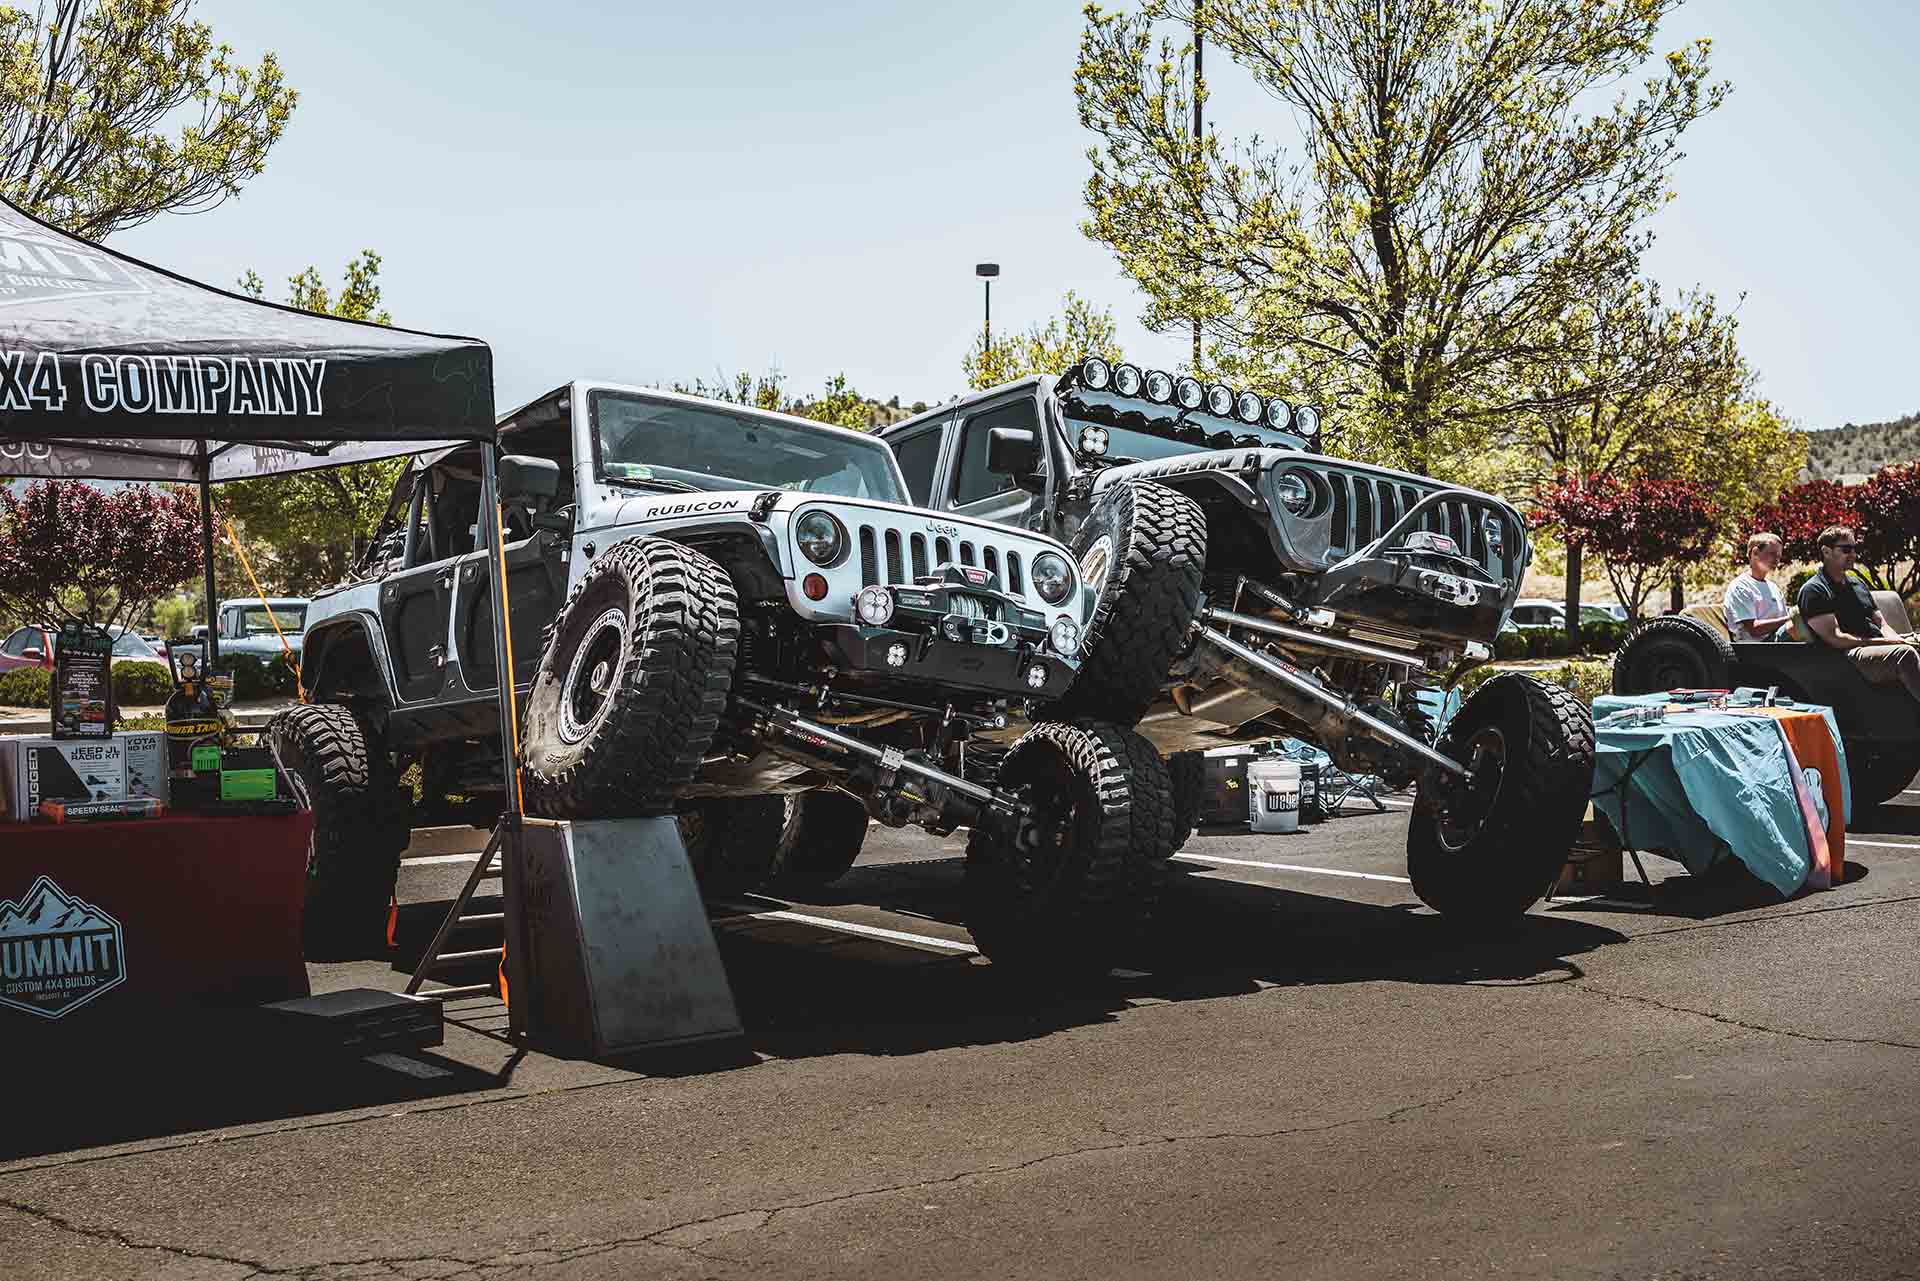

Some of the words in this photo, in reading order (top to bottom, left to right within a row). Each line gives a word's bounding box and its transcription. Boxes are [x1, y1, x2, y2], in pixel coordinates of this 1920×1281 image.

[80, 353, 327, 416] COMPANY
[646, 500, 739, 518] RUBICON
[926, 520, 959, 538] Jeep
[71, 746, 103, 755] JEEP
[71, 753, 103, 761] RADIO
[28, 748, 40, 816] RUGGED
[1268, 791, 1299, 811] webe
[0, 932, 114, 979] UMMIT
[6, 981, 43, 994] CUSTOM
[45, 978, 64, 991] 4X4
[65, 975, 97, 988] BUILDS
